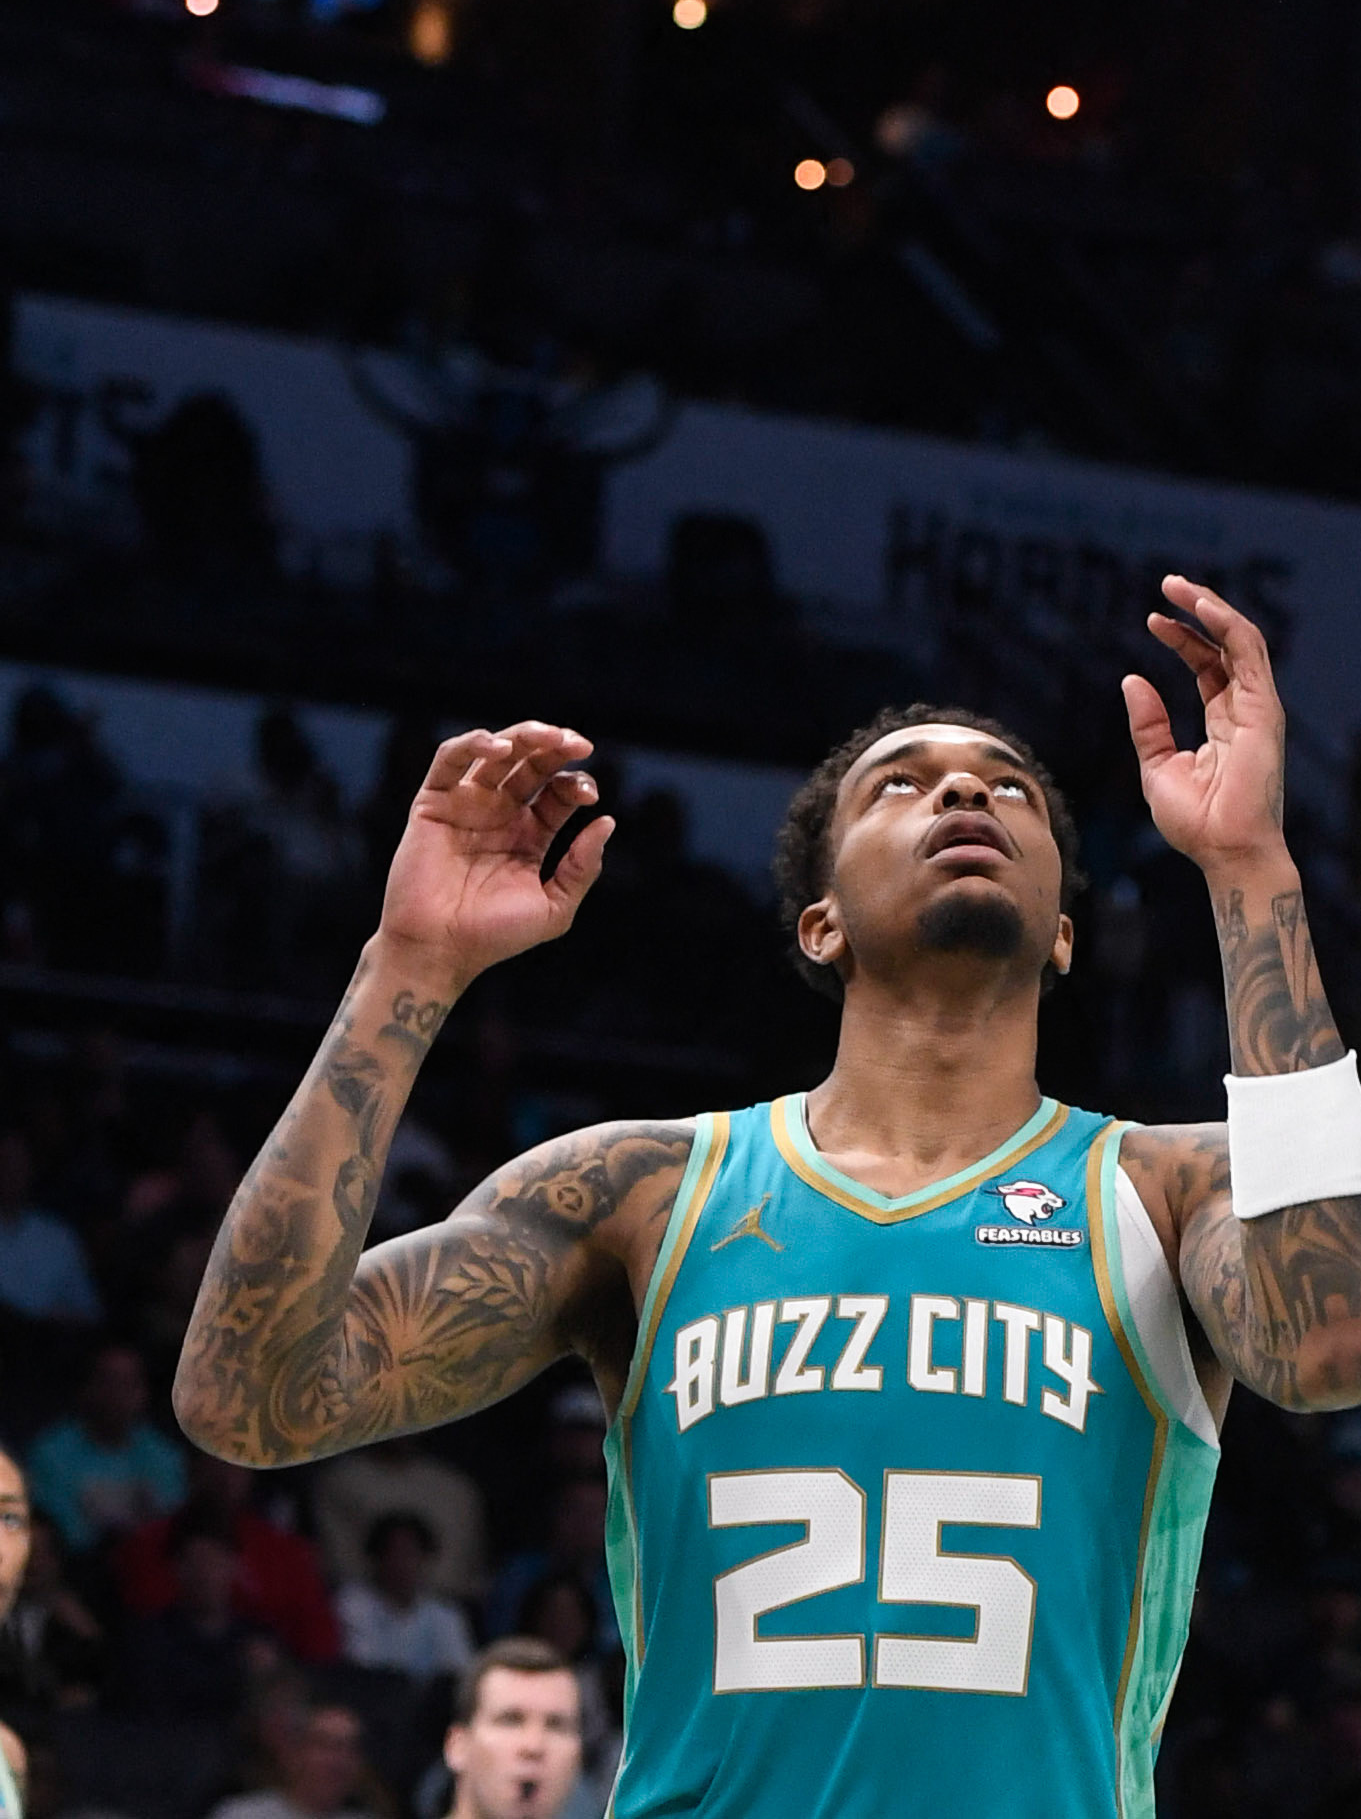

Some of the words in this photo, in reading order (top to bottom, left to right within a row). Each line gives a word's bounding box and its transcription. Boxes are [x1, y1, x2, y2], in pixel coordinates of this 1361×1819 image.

[978, 1227, 1081, 1245] FEASTABLES
[664, 1295, 890, 1434] BUZZ
[906, 1294, 1106, 1434] CITY
[706, 1467, 1042, 1696] 25
